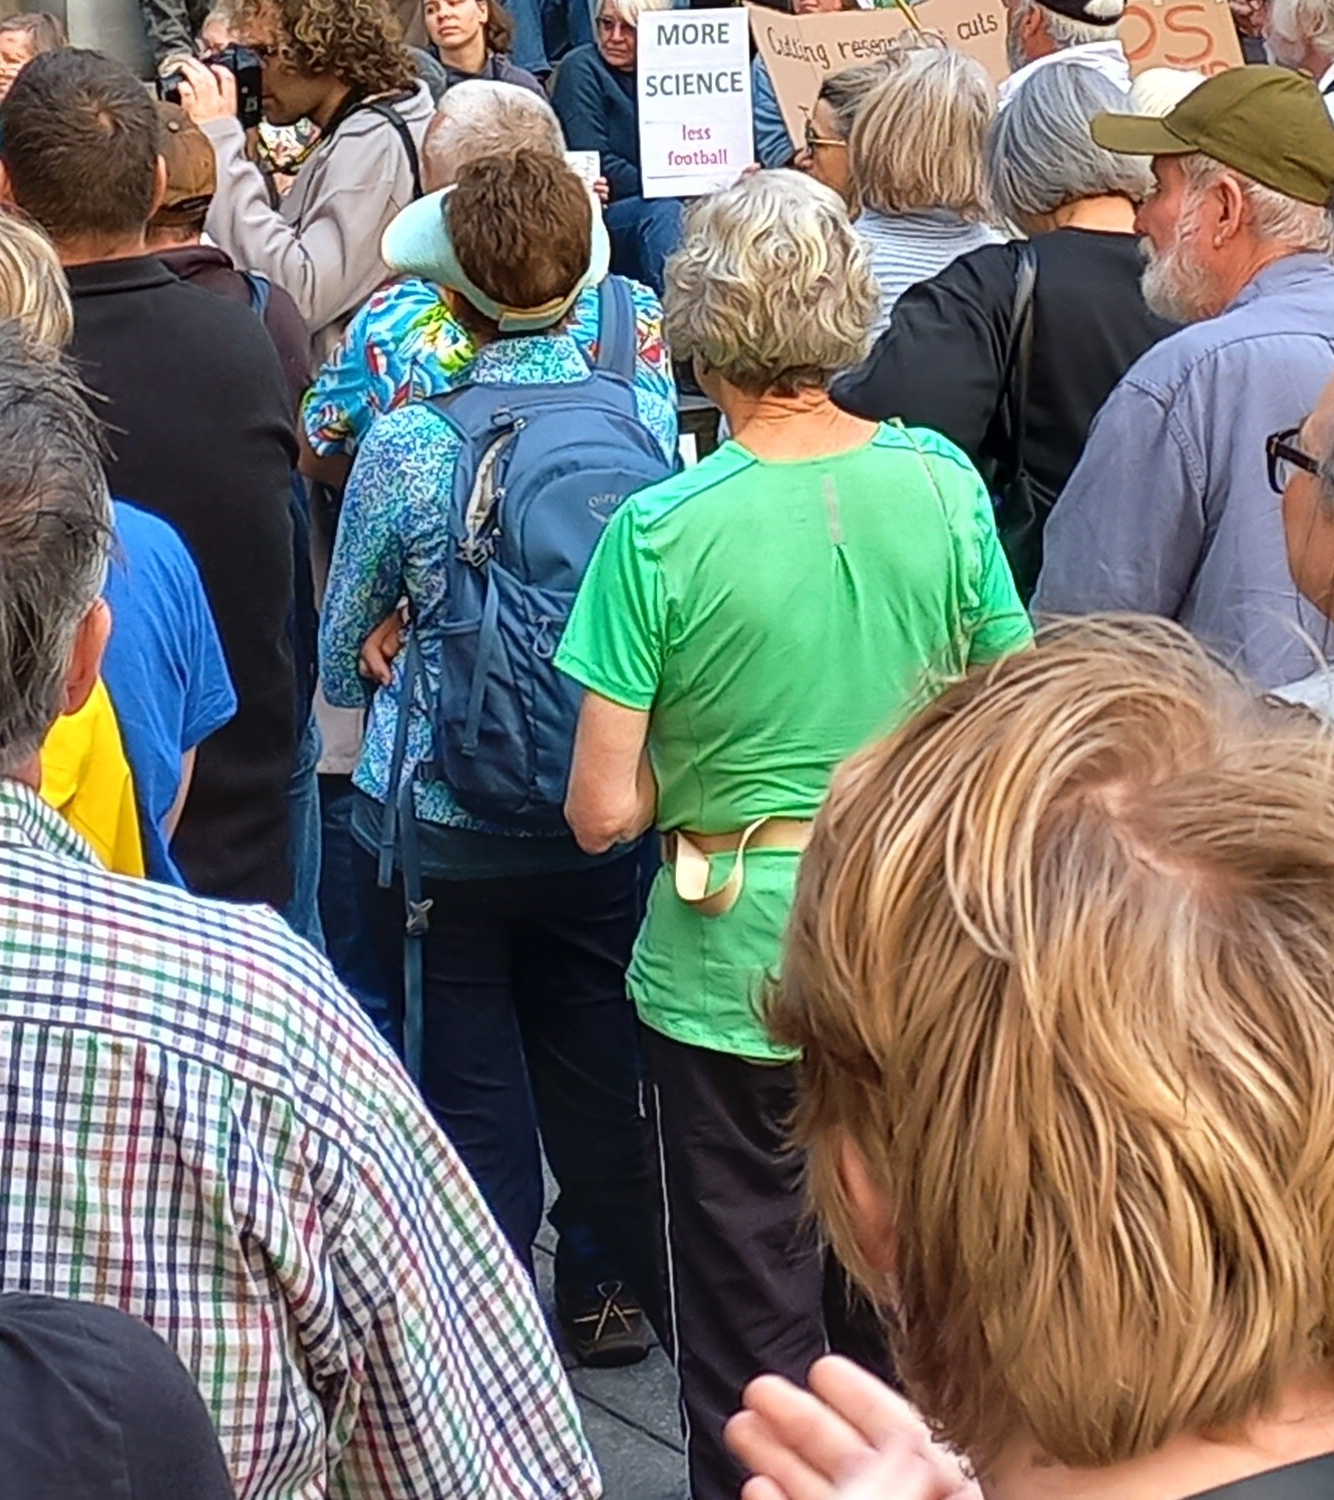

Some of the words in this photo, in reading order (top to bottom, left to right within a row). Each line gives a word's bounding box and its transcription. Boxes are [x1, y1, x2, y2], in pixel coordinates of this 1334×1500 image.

[657, 23, 730, 46] MORE
[767, 26, 829, 70] Cutting
[837, 37, 898, 60] resear
[956, 13, 998, 41] cuts
[645, 71, 744, 97] SCIENCE
[682, 124, 711, 141] less
[667, 149, 727, 166] football
